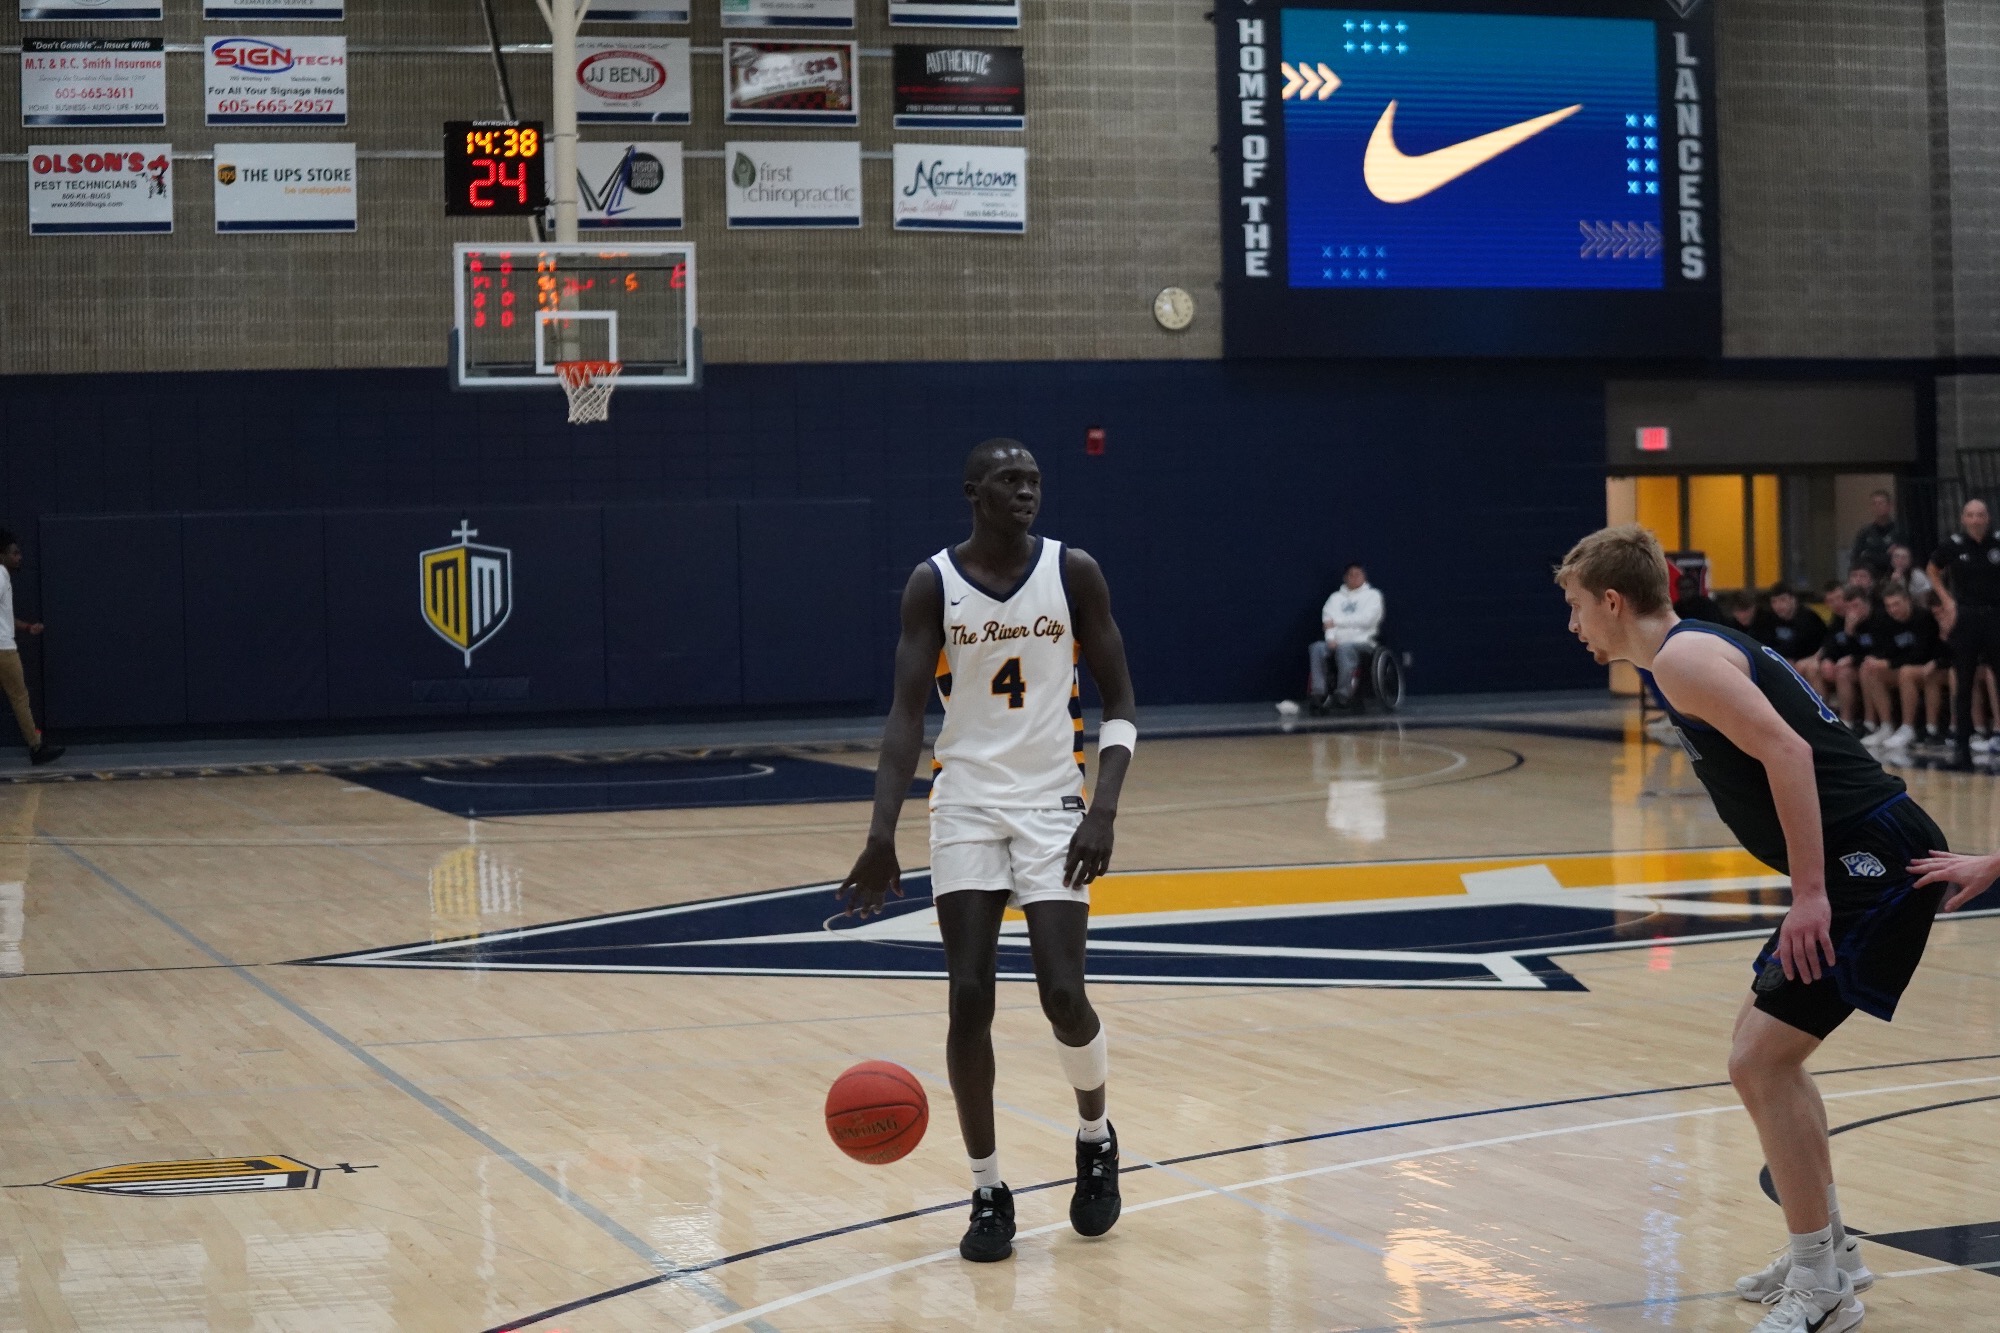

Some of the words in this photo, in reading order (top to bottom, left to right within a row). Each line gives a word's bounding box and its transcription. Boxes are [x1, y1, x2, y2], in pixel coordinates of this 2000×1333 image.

[103, 41, 129, 50] Insure
[131, 41, 150, 50] With
[213, 48, 292, 66] SIGN
[296, 56, 344, 66] TECH
[49, 58, 56, 69] &
[82, 57, 111, 69] Smith
[114, 57, 161, 69] Insurance
[586, 67, 604, 83] JJ
[609, 66, 656, 83] BENJI
[926, 49, 992, 76] AUTHENTIC
[1236, 18, 1267, 126] HOME
[55, 87, 134, 99] 605-665-3611
[208, 87, 224, 95] For
[228, 87, 241, 95] All
[244, 87, 267, 95] Your
[270, 87, 311, 98] Signage
[314, 86, 345, 95] Needs
[218, 99, 334, 113] 605-665-2957
[467, 128, 538, 157] 14:38
[33, 152, 145, 174] OLSON'S
[1242, 134, 1270, 189] OF
[1672, 31, 1707, 280] LANCERS
[242, 168, 268, 182] THE
[274, 168, 302, 182] UPS
[307, 168, 352, 182] STORE
[469, 159, 527, 208] 24
[760, 161, 792, 182] first
[903, 160, 1017, 197] Northtown
[34, 181, 62, 190] PEST
[65, 180, 137, 190] TECHNICIANS
[748, 182, 855, 208] chiropractic
[1241, 196, 1271, 277] THE
[951, 624, 977, 646] The
[981, 621, 1030, 643] River
[1033, 615, 1066, 645] City
[991, 656, 1028, 711] 4
